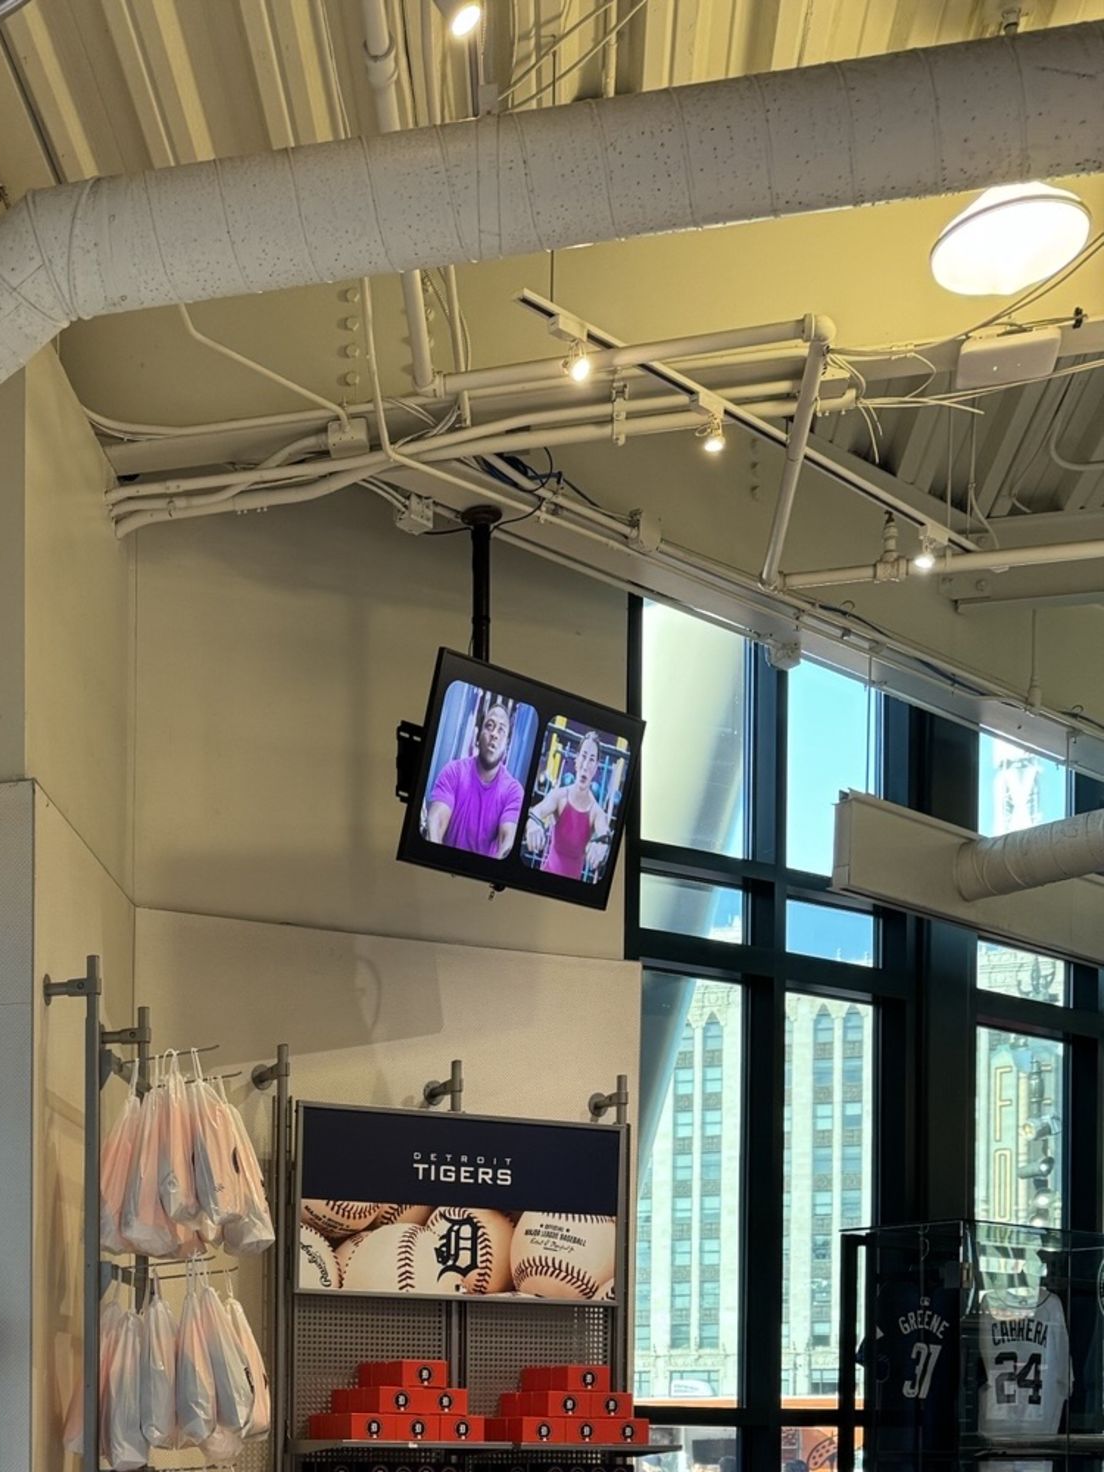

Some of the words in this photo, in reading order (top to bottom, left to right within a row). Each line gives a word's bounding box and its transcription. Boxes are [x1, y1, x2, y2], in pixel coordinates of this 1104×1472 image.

[413, 1151, 512, 1166] DETROIT
[413, 1163, 512, 1185] TIGERS
[899, 1310, 950, 1340] GREENE
[994, 1351, 1043, 1405] 24
